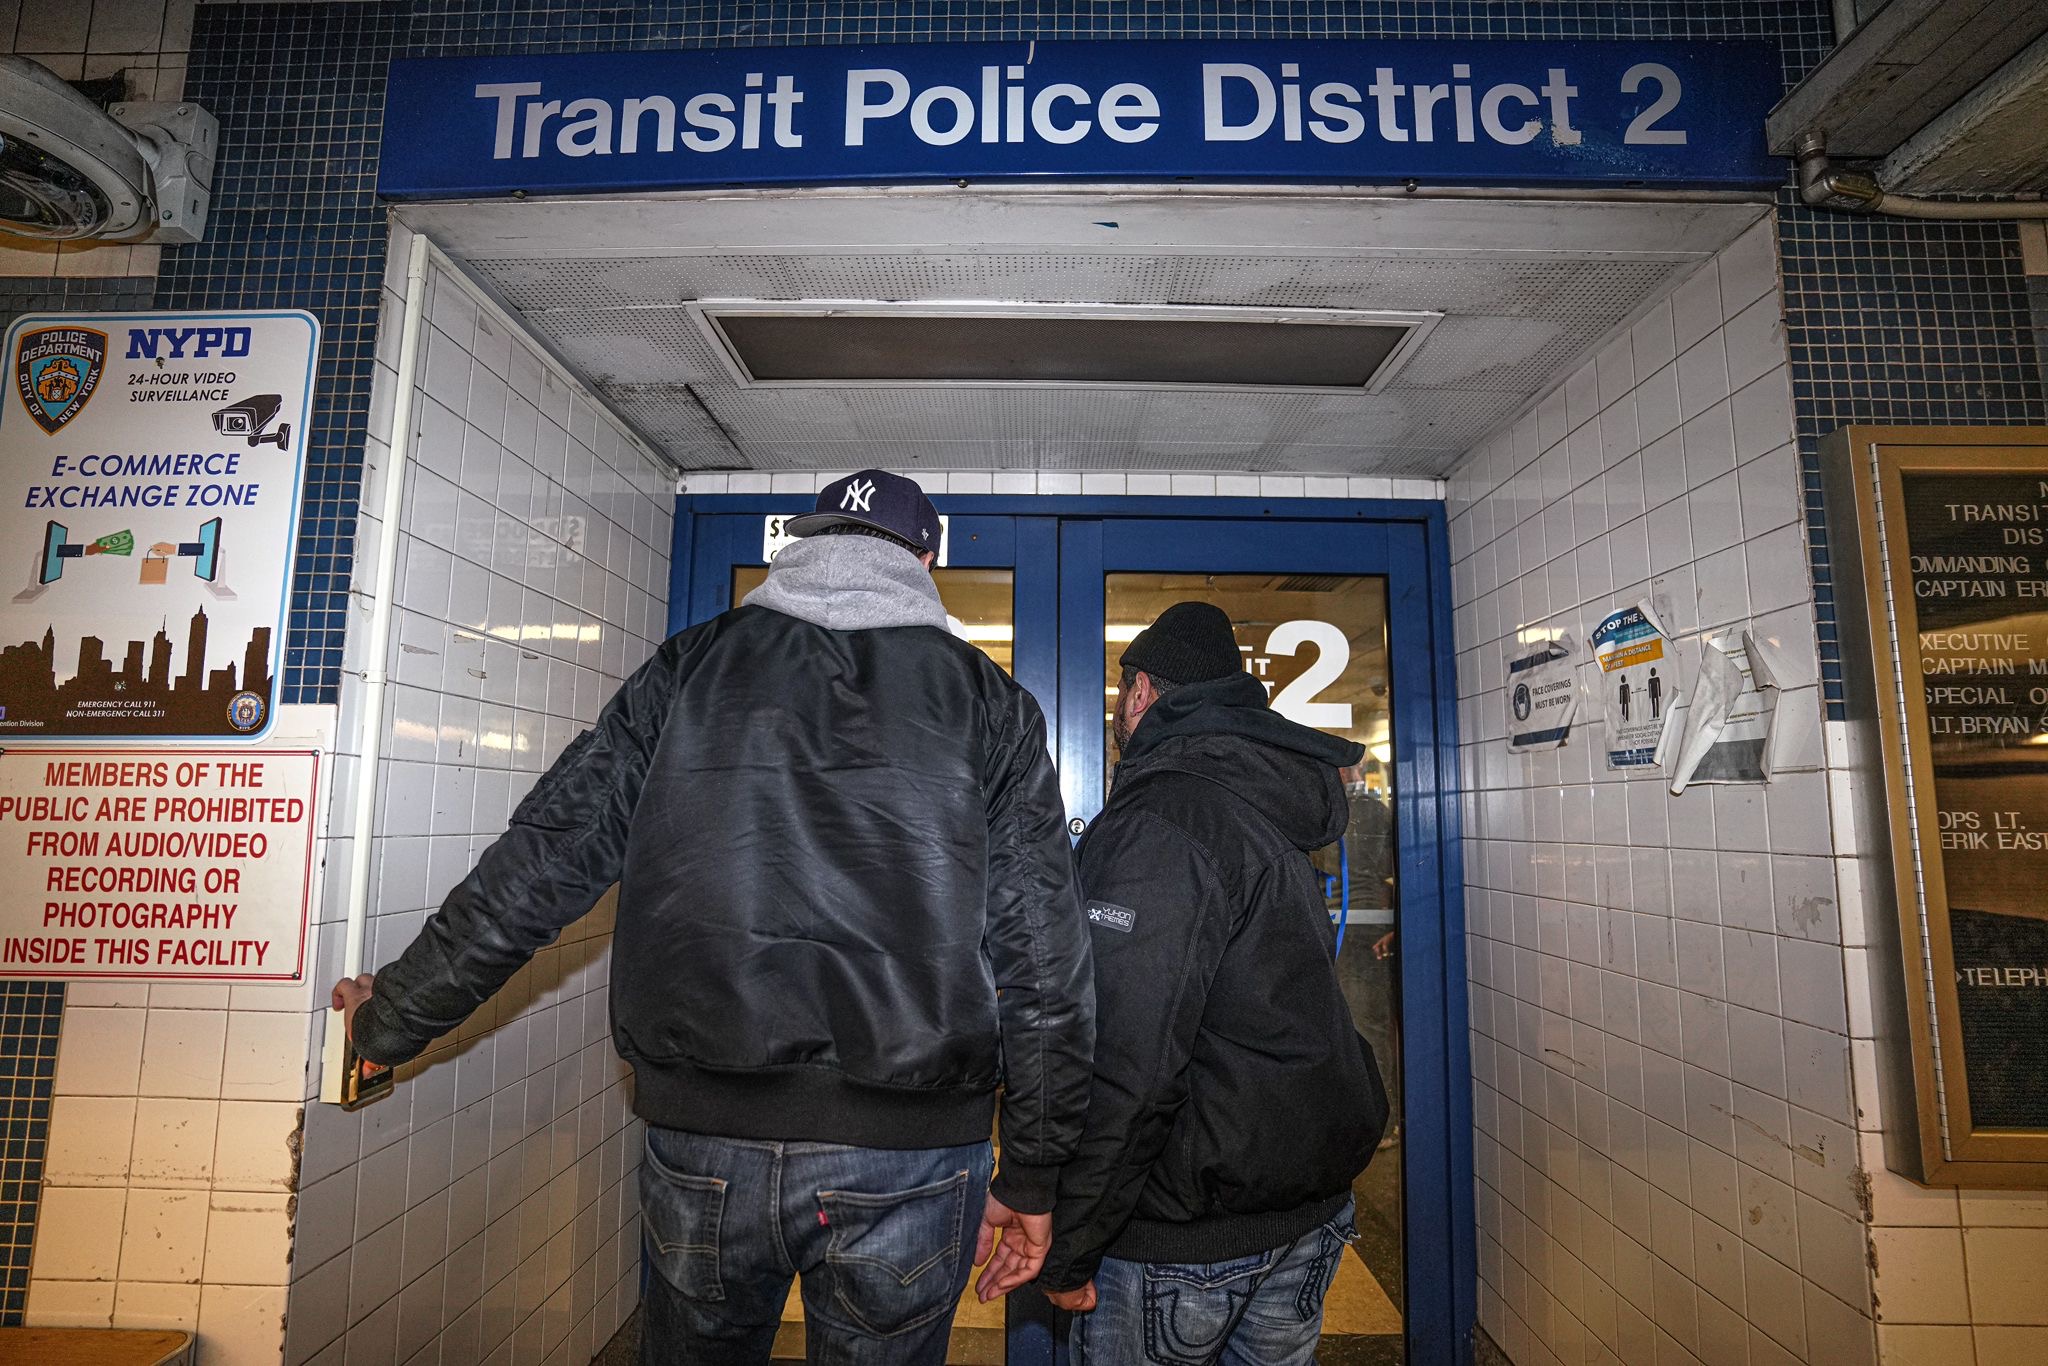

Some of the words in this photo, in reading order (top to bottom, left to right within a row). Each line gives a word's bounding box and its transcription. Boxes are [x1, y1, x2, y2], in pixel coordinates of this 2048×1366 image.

[475, 73, 804, 159] Transit
[845, 66, 1160, 146] Police
[1202, 63, 1582, 146] District
[1620, 62, 1688, 145] 2
[41, 331, 87, 344] POLICE
[125, 327, 251, 359] NYPD
[21, 343, 102, 364] DEPARTMENT
[127, 373, 189, 386] 24-HOUR
[193, 372, 236, 385] VIDEO
[20, 373, 34, 399] CITY
[30, 403, 43, 416] OF
[58, 401, 80, 423] NEW
[80, 368, 100, 397] YORK
[130, 389, 229, 402] SURVEILLANCE
[51, 453, 240, 477] E-COMMERCE
[25, 485, 179, 508] EXCHANGE
[185, 484, 259, 507] ZONE
[2002, 527, 2048, 545] DIS
[1915, 580, 2006, 597] CAPTAIN
[1595, 619, 1621, 639] STOP
[1623, 613, 1638, 626] THE
[1265, 620, 1353, 729] 2
[1922, 657, 2015, 675] CAPTAIN
[1532, 686, 1544, 697] FACE
[1544, 678, 1572, 694] COVERINGS
[1925, 687, 2014, 704] SPECIAL
[66, 710, 131, 718] NON-EMERGENCY
[133, 710, 151, 718] CALL
[152, 710, 165, 718] 311
[1535, 699, 1548, 710] MUST
[1548, 698, 1555, 706] BE
[1555, 694, 1571, 705] WORN
[45, 762, 169, 788] MEMBERS
[176, 762, 210, 788] OF
[216, 763, 264, 788] THE
[0, 796, 89, 822] PUBLIC
[95, 797, 147, 822] ARE
[153, 797, 304, 823] PROHIBITED
[1993, 812, 2026, 830] LT.
[27, 831, 100, 857] FROM
[105, 832, 268, 859] AUDIO/VIDEO
[1940, 832, 1990, 850] ERIK
[46, 866, 196, 893] RECORDING
[204, 868, 241, 894] OR
[43, 902, 238, 930] PHOTOGRAPHY
[3, 937, 87, 964] INSIDE
[94, 938, 150, 965] THIS
[156, 939, 270, 967] FACILITY
